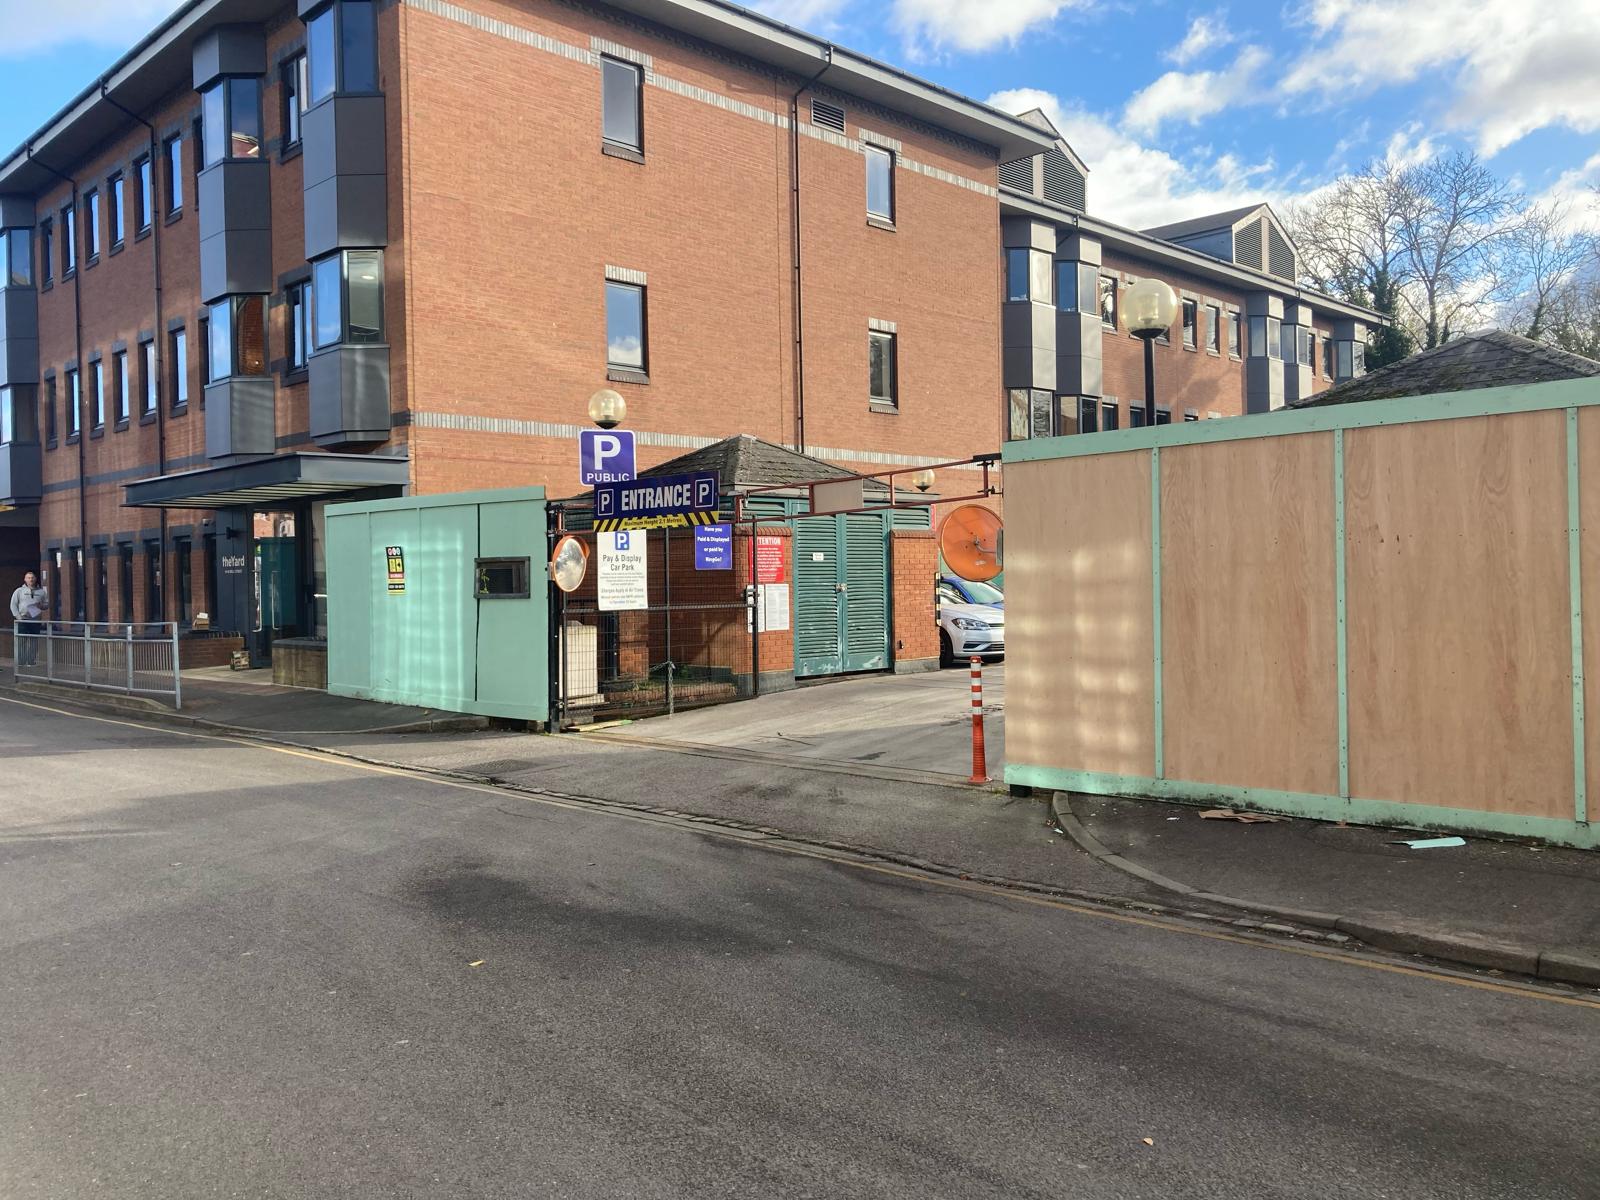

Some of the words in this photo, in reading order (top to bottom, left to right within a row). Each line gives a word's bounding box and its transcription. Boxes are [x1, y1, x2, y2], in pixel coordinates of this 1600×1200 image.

[594, 434, 621, 470] P
[586, 472, 630, 482] PUBLIC
[601, 493, 610, 511] P
[621, 484, 691, 511] ENTRANCE
[699, 483, 710, 503] P
[603, 555, 613, 563] Pay
[621, 554, 641, 563] Display
[611, 563, 620, 571] Car
[622, 563, 634, 571] Park
